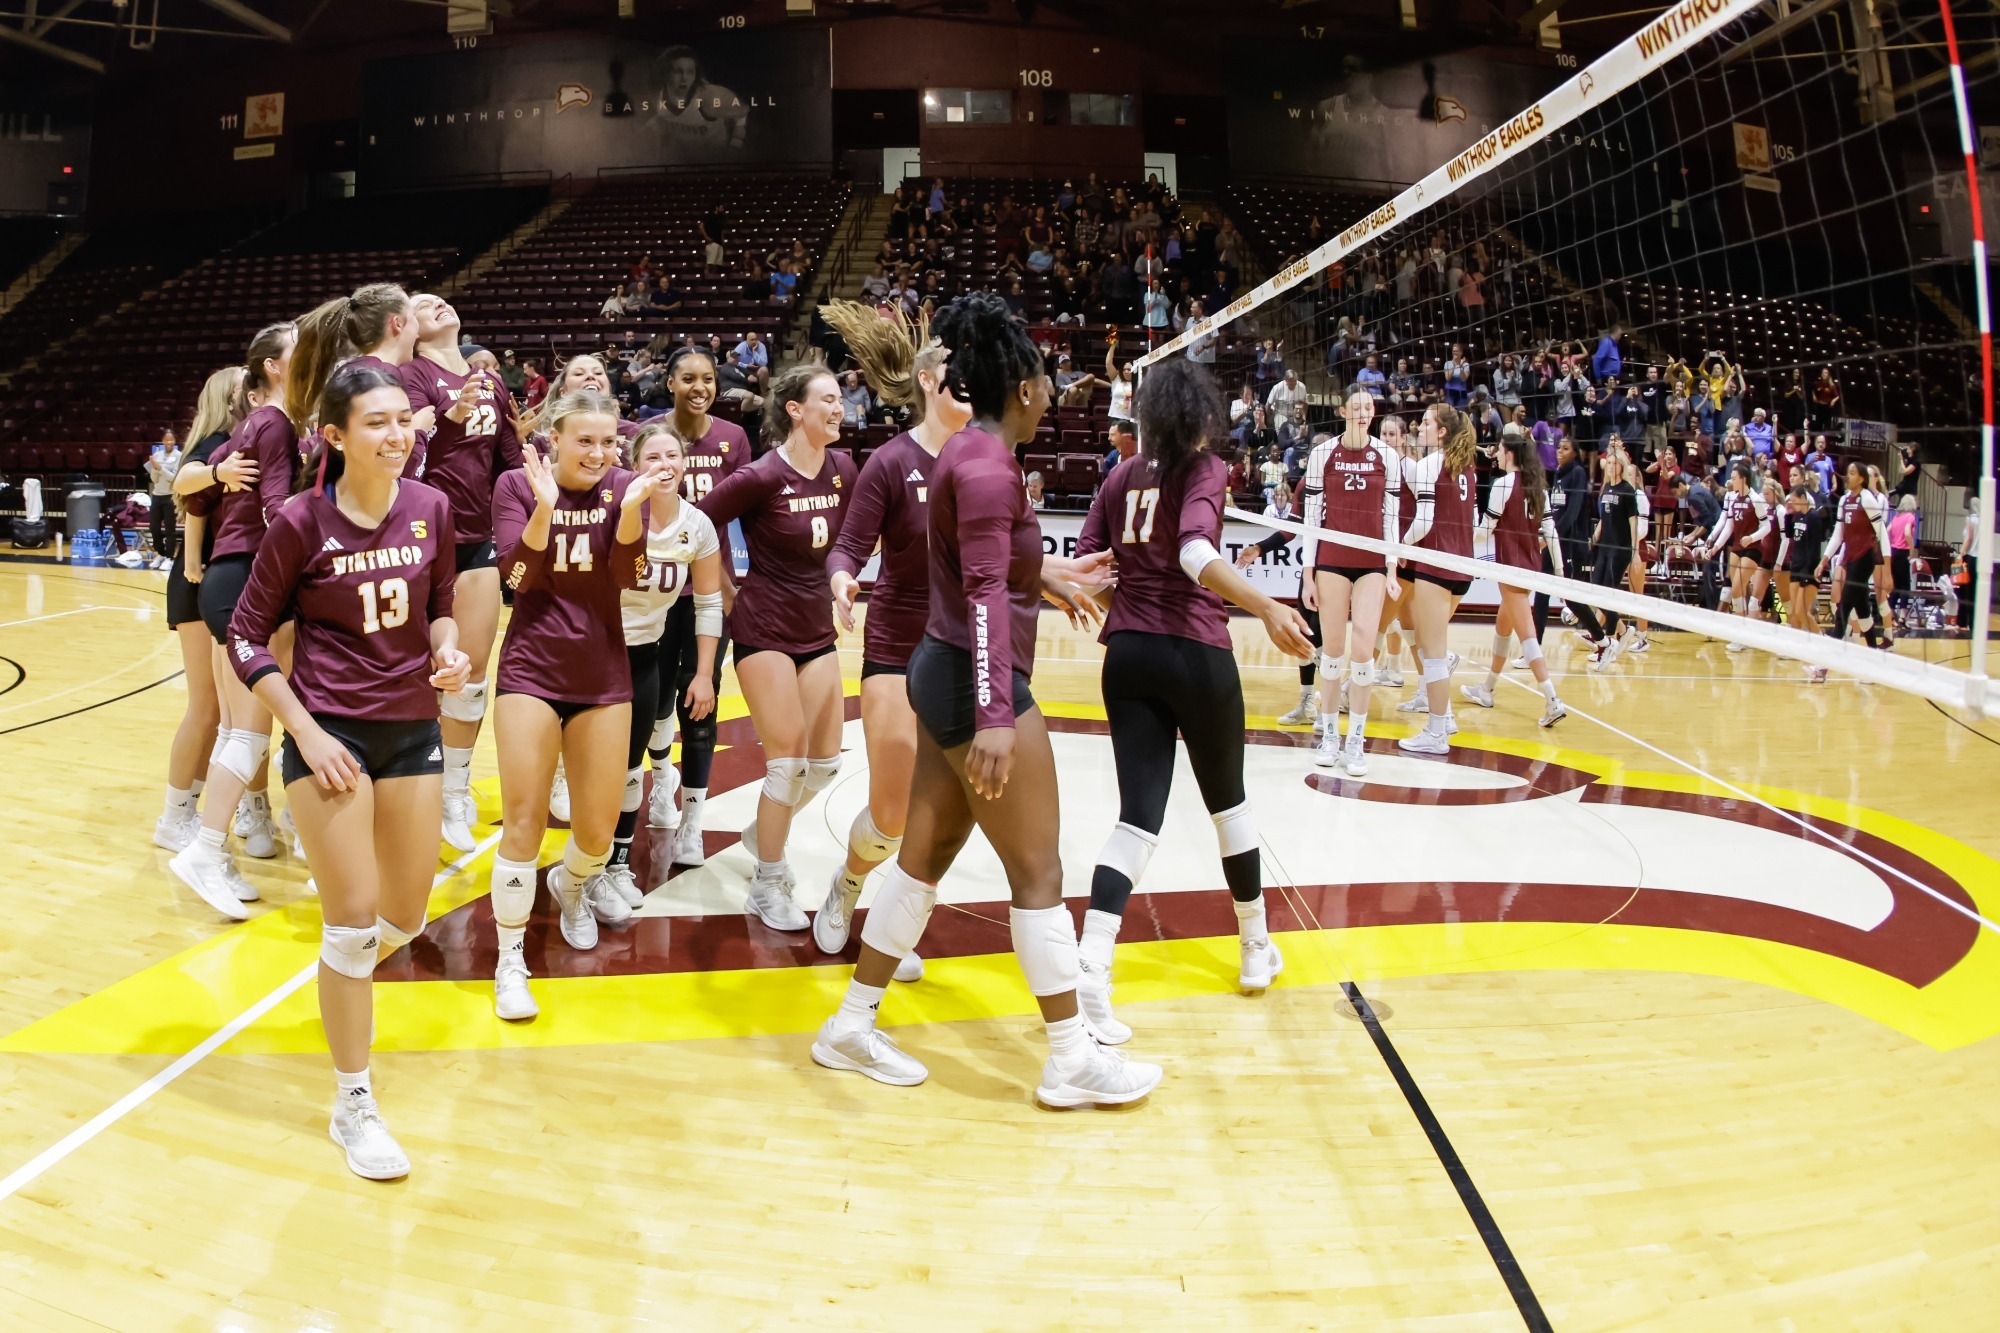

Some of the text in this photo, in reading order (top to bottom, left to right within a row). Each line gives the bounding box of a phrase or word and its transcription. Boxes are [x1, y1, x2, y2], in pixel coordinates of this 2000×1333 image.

[718, 16, 745, 28] 109
[453, 36, 477, 49] 110
[1555, 54, 1577, 68] 106
[1019, 70, 1053, 87] 108
[605, 96, 776, 113] BASKETBALL
[220, 114, 238, 130] 111
[414, 107, 540, 127] WINTHROP
[1446, 105, 1544, 183] WINTHROP EAGLES
[1773, 144, 1796, 162] 105
[1340, 201, 1397, 249] WINTHROP EAGLES
[465, 404, 498, 437] 22
[683, 472, 714, 503] 19
[1344, 473, 1367, 491] 25
[1458, 473, 1468, 501] 9
[788, 493, 840, 513] WINTHROP
[552, 508, 607, 527] INTHROP
[1121, 487, 1160, 544] 17
[811, 516, 829, 549] 8
[332, 545, 423, 576] WINTHROP
[553, 532, 594, 573] 14
[357, 577, 410, 634] 13
[975, 603, 991, 707] EVERSTAND
